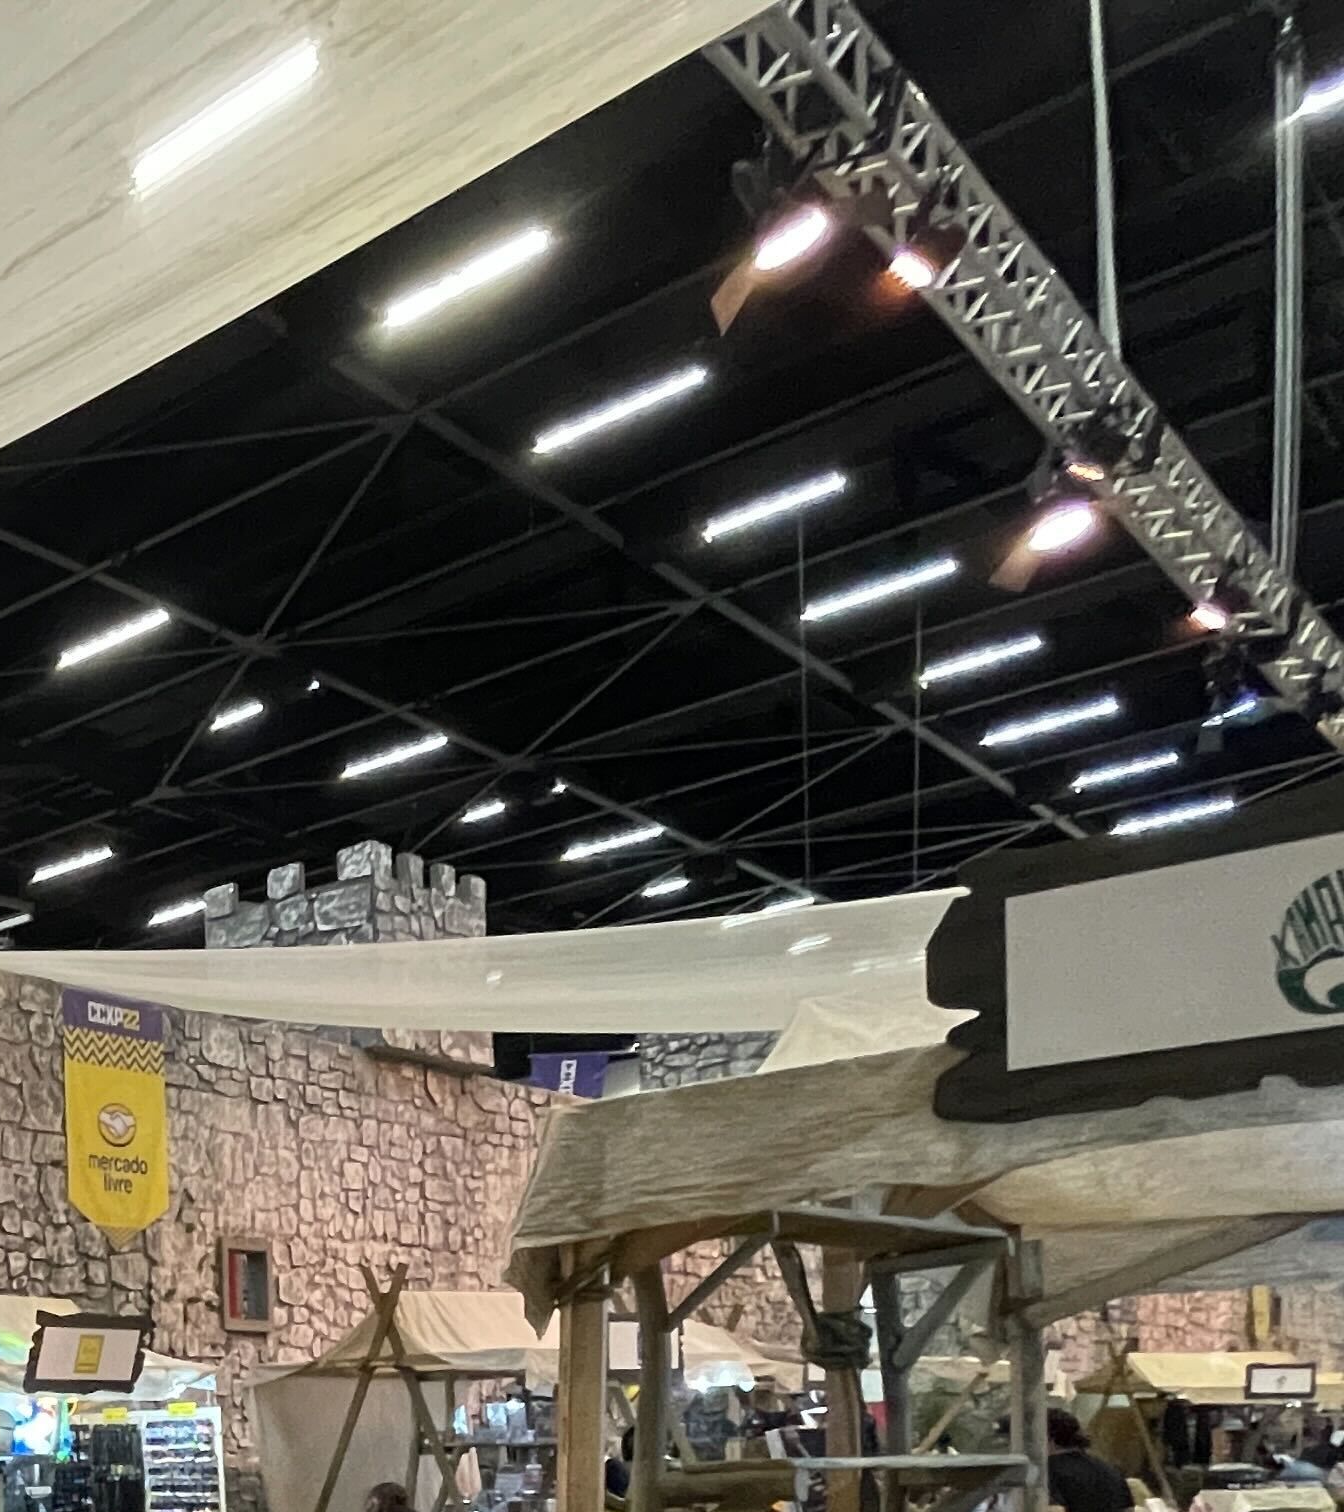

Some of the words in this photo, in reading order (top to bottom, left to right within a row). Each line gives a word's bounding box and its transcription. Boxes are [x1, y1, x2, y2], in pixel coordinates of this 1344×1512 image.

[87, 1000, 140, 1032] CCXP22
[88, 1153, 148, 1175] mercado
[103, 1173, 133, 1194] livre
